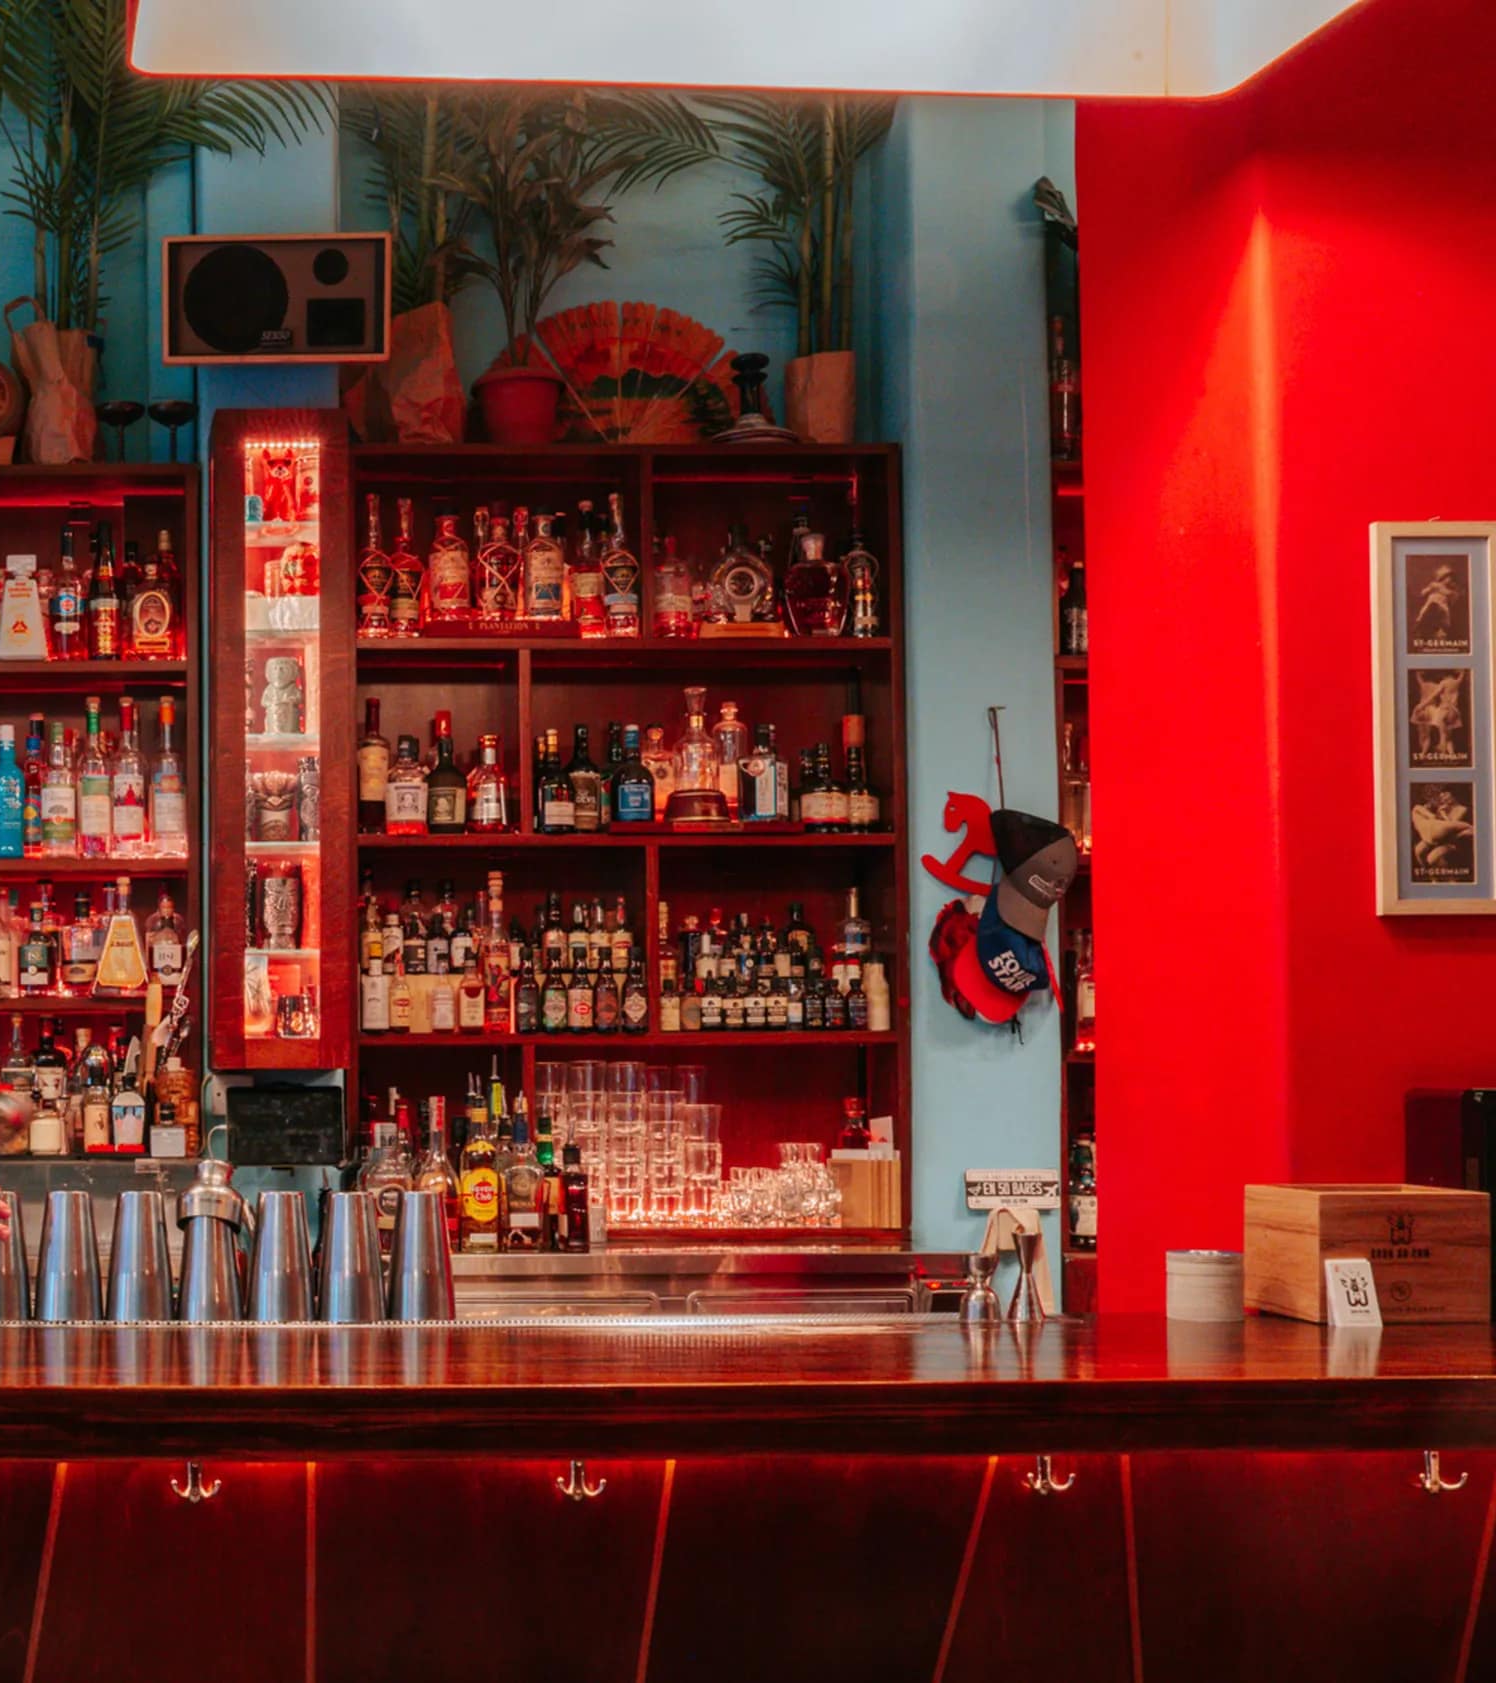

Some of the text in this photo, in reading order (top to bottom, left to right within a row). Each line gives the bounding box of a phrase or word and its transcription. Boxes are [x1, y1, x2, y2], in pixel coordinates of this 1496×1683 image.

[988, 956, 1025, 992] STAR
[1000, 949, 1037, 986] FOUR
[983, 1181, 996, 1195] EN
